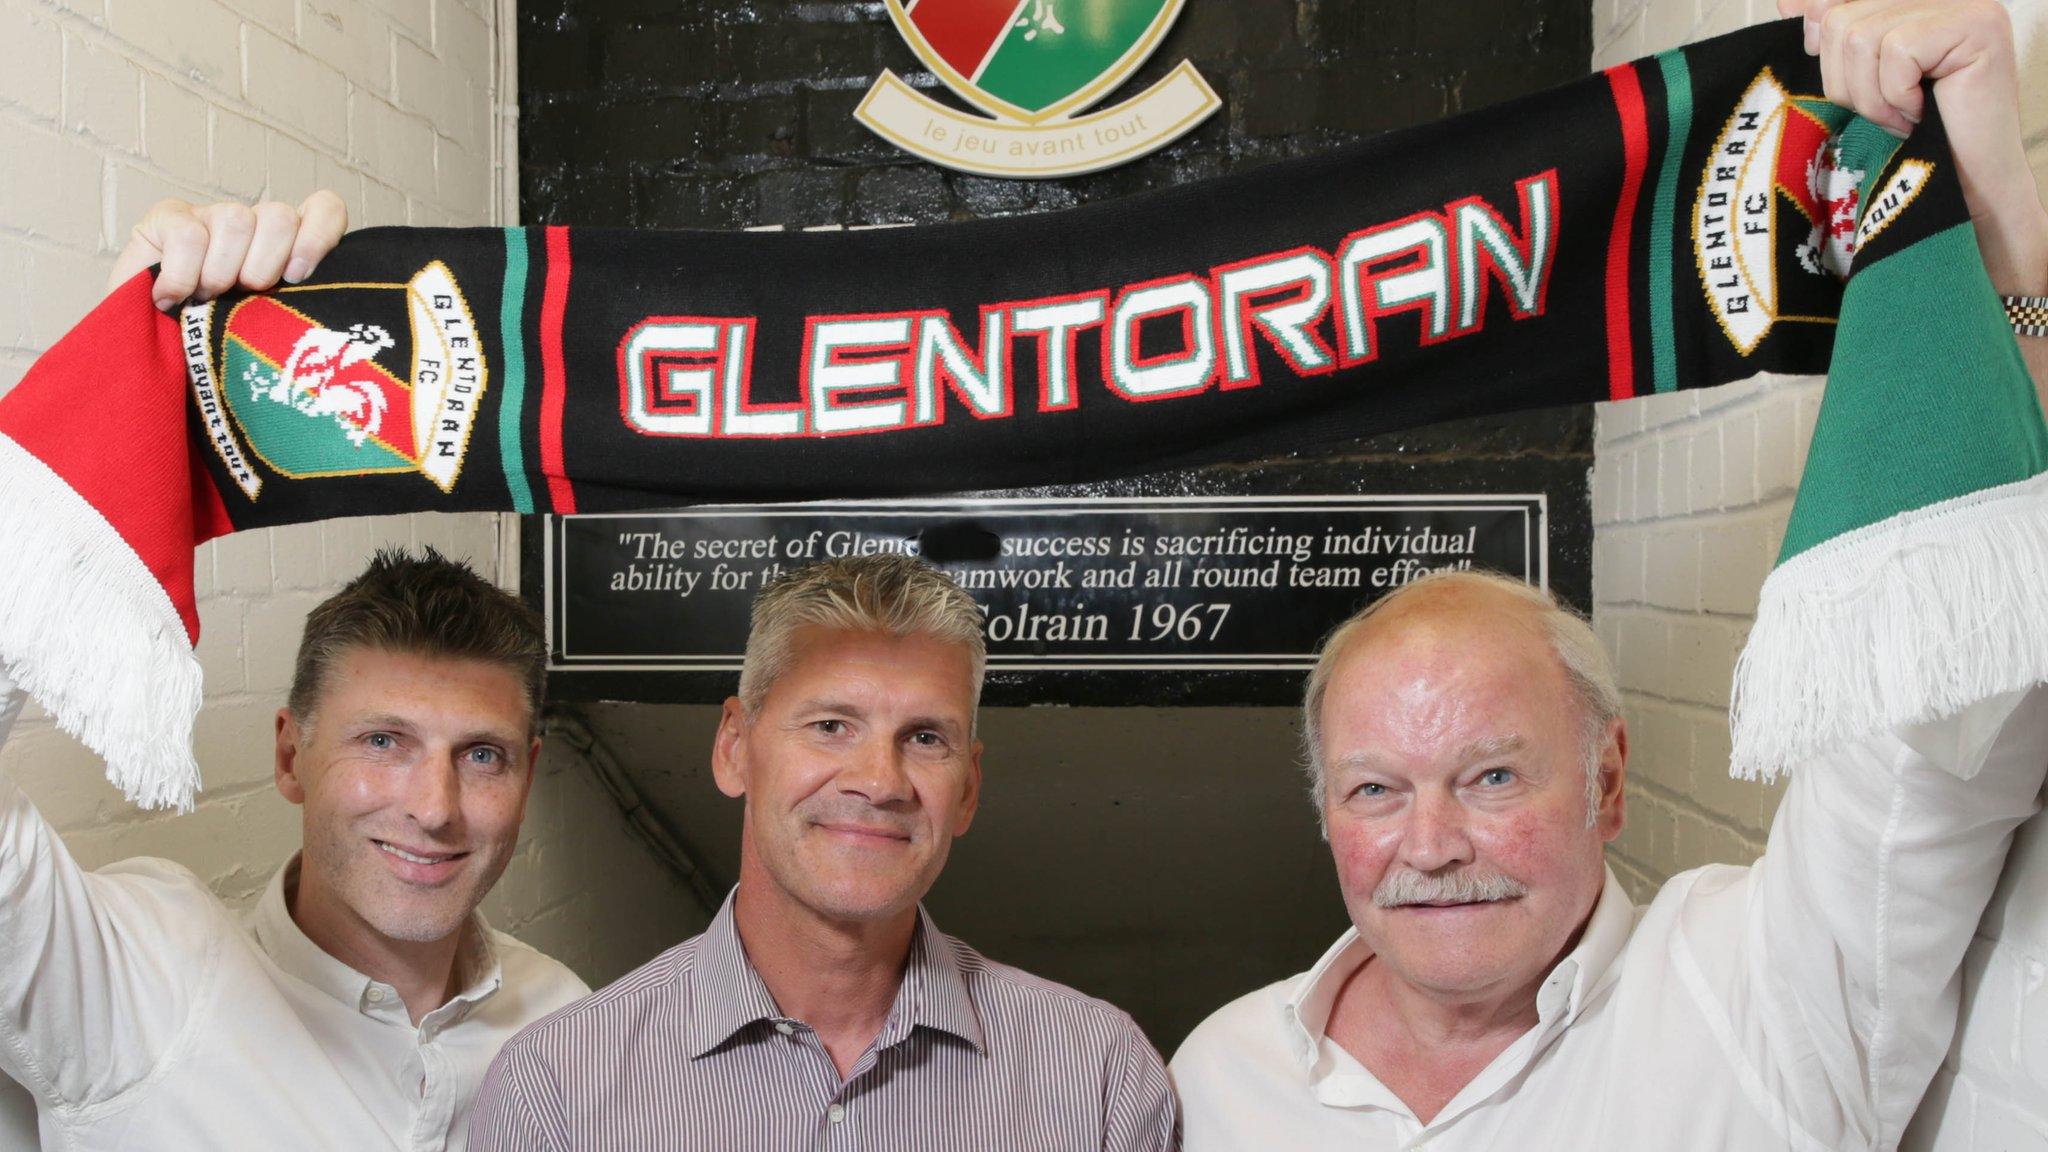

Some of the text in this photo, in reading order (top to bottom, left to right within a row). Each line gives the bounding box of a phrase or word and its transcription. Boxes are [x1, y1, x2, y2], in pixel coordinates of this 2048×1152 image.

[922, 114, 1148, 157] le jeu avant tout
[1704, 111, 1759, 315] GLENTORAN
[1744, 191, 1769, 235] FC
[617, 169, 1558, 440] GLENTORAN
[418, 359, 441, 384] FC
[433, 294, 476, 457] GLENTORAN
[217, 433, 250, 482] tout
[619, 532, 685, 559] "The
[693, 535, 778, 559] secret
[785, 531, 822, 558] of
[1001, 535, 1112, 557] success
[1120, 528, 1145, 556] is
[1154, 527, 1314, 562] sacrificing
[1322, 526, 1477, 555] individual
[610, 563, 702, 598] ability
[709, 563, 753, 590] for
[941, 561, 1074, 589] amwork
[1081, 560, 1137, 588] and
[1144, 560, 1183, 588] all
[1190, 559, 1280, 588] round
[1289, 562, 1361, 587] team
[977, 602, 1232, 642] olrain 1967
